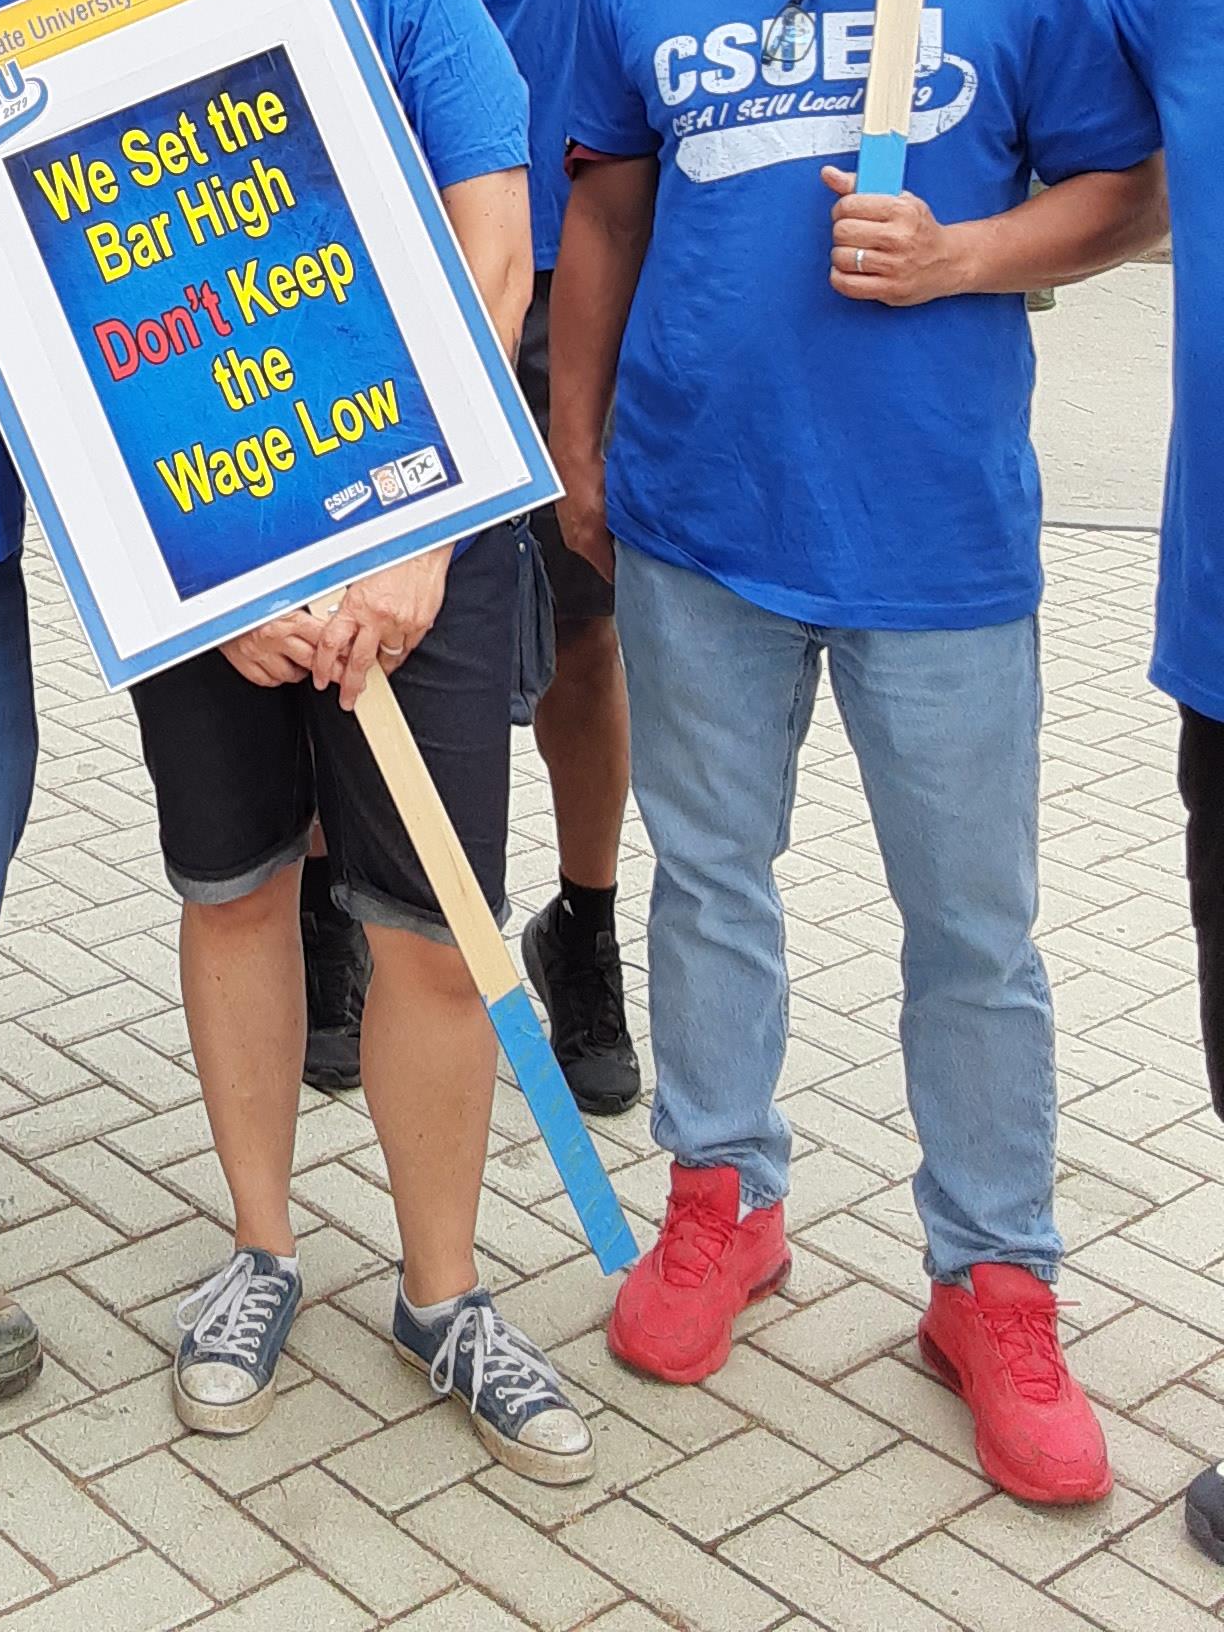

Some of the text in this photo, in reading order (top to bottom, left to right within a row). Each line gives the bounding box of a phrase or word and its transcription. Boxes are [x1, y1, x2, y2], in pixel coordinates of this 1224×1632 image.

[33, 88, 289, 223] We Set the
[673, 105, 712, 137] CSEA
[737, 92, 792, 121] SEIU
[799, 88, 860, 112] Local
[84, 158, 297, 284] Bar High
[94, 239, 355, 381] Don't Keep
[212, 346, 295, 412] the
[154, 378, 401, 514] Wage Low
[407, 454, 434, 483] apc
[324, 480, 364, 511] CSUEU
